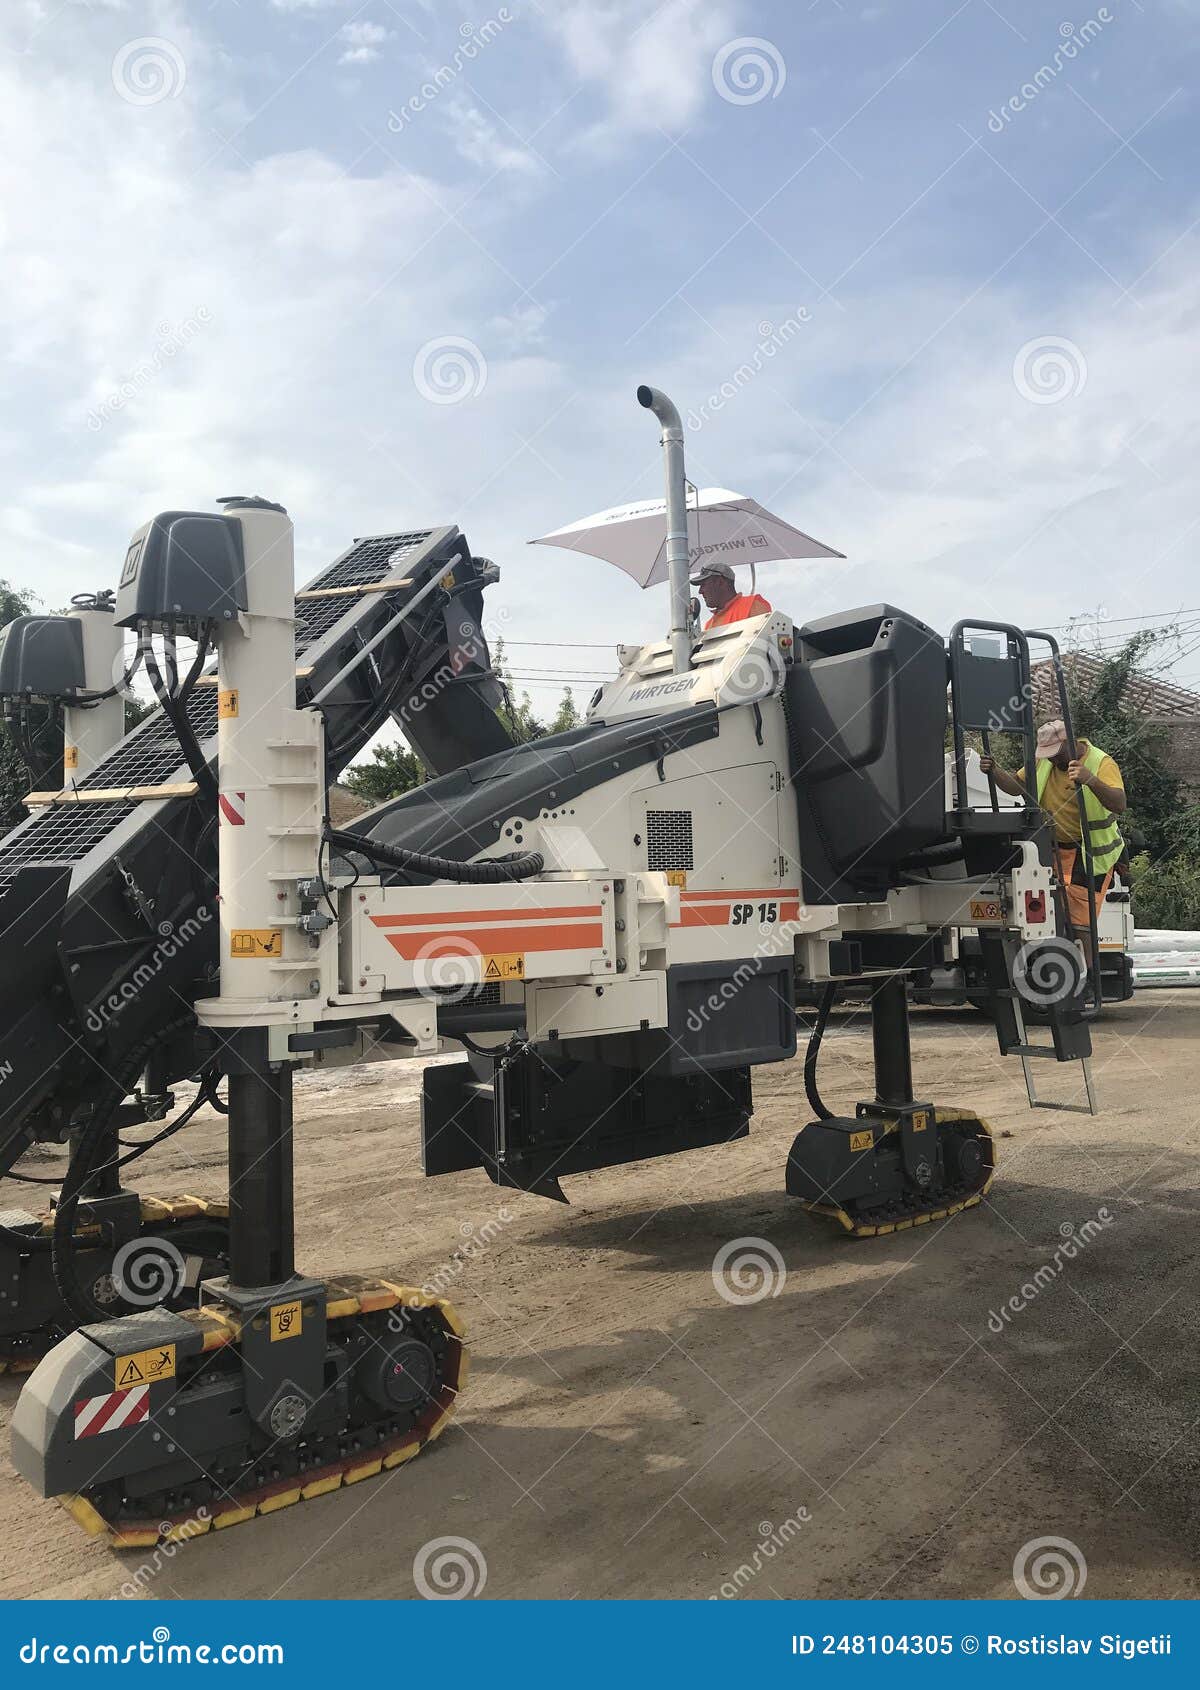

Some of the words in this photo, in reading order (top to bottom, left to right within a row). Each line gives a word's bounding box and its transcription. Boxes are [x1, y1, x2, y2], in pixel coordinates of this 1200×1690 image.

[628, 677, 700, 702] WIRTGEN
[732, 904, 753, 925] SP
[758, 903, 777, 923] 15
